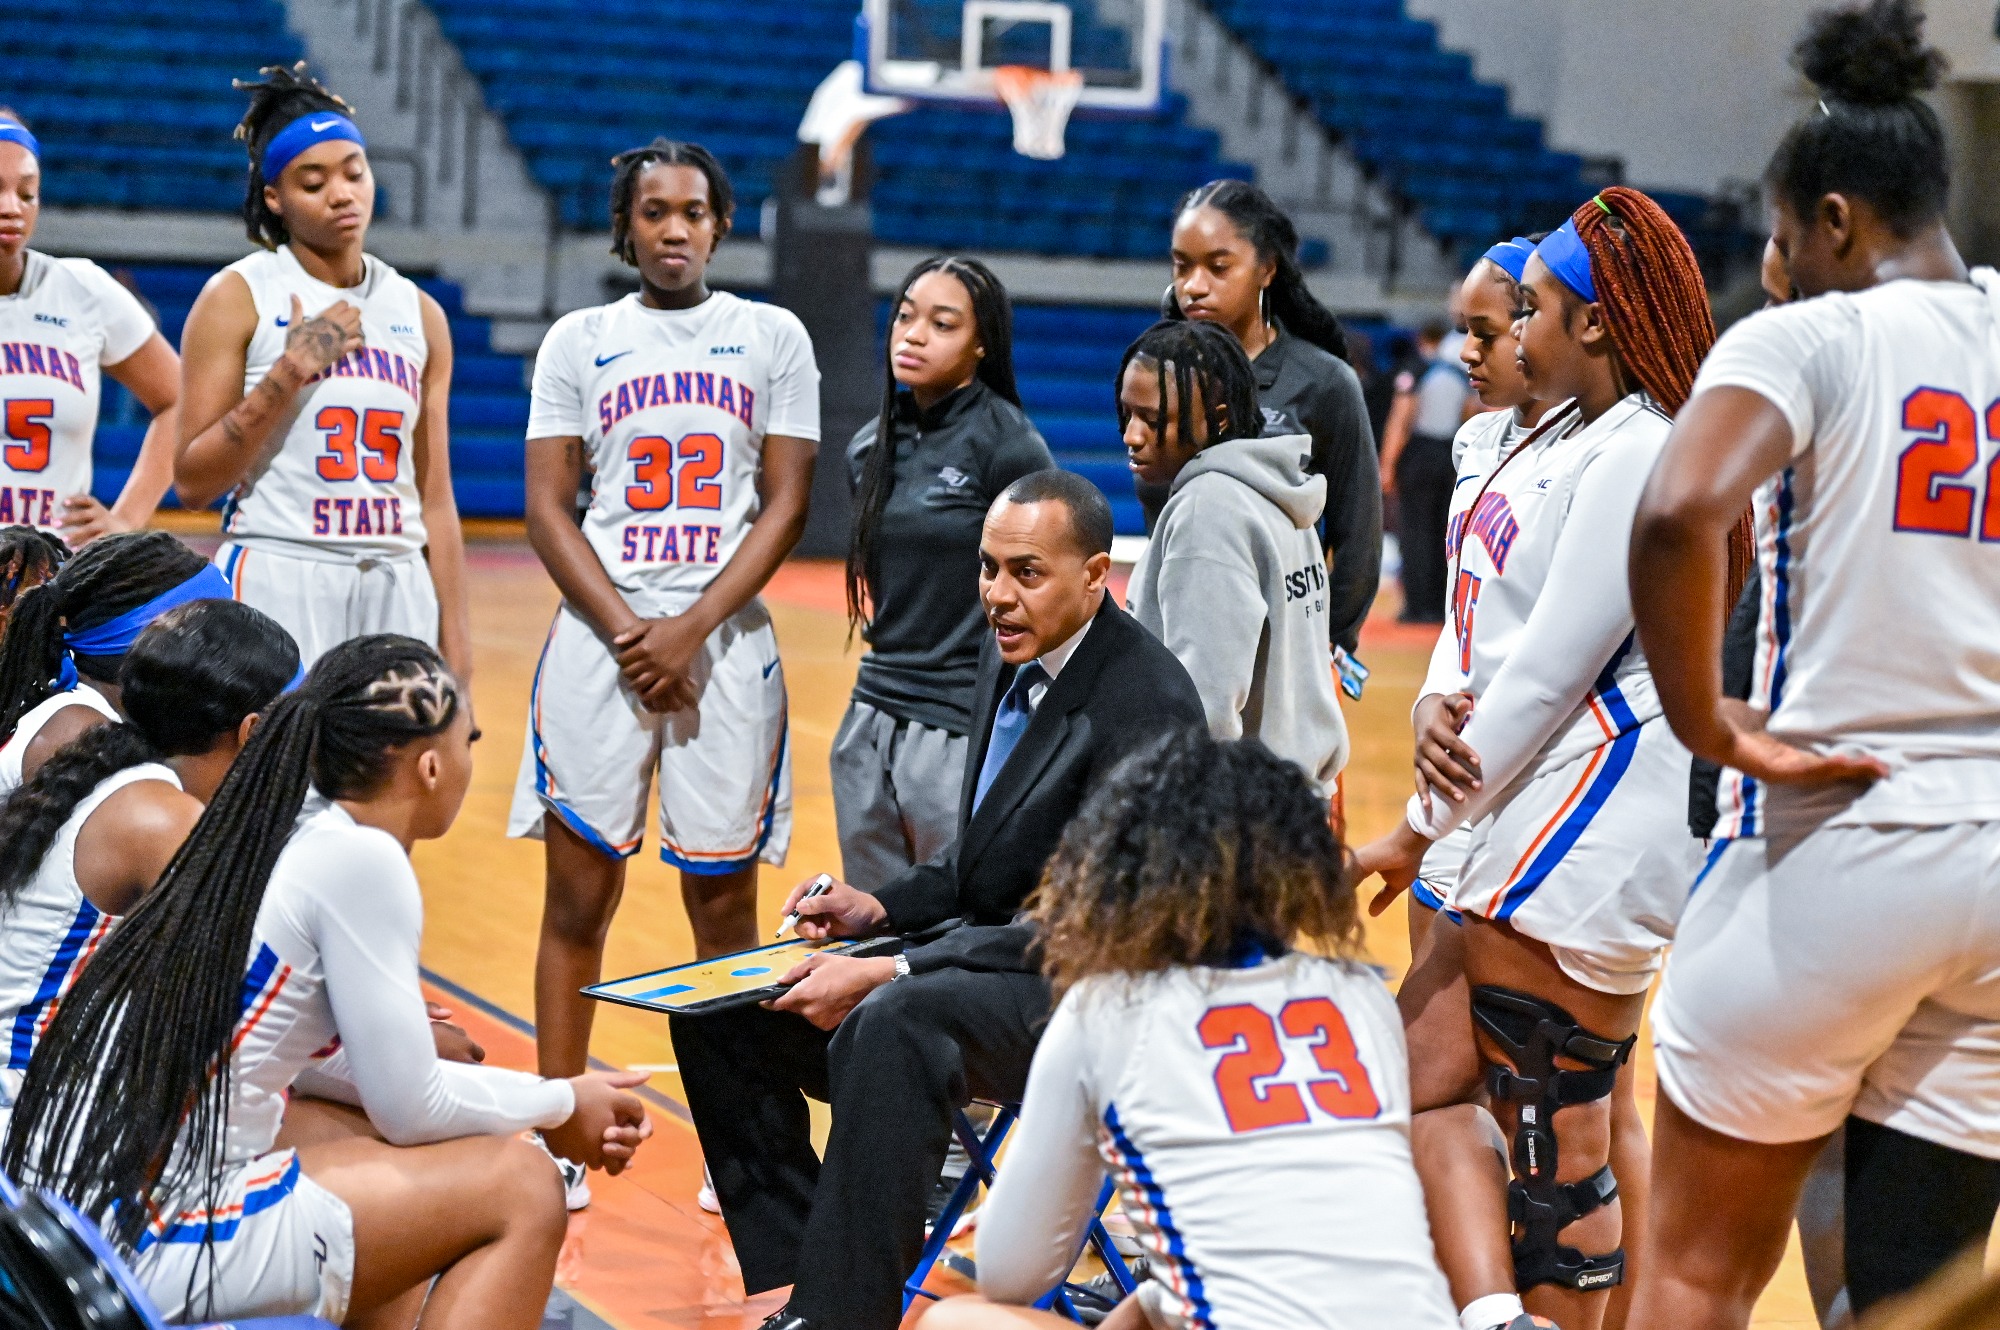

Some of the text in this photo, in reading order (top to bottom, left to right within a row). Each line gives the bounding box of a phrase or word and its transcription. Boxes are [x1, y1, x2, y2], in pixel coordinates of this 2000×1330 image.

[34, 313, 68, 328] SIAC
[710, 345, 746, 355] SIAC
[0, 342, 86, 394] NNAH
[598, 370, 756, 437] SAVANNAH
[4, 398, 54, 473] 5
[315, 406, 404, 484] 35
[1893, 386, 2000, 543] 2
[625, 433, 724, 512] 32
[0, 487, 55, 526] ATE
[313, 498, 402, 536] STATE
[621, 523, 721, 563] STATE
[1196, 997, 1382, 1134] 23
